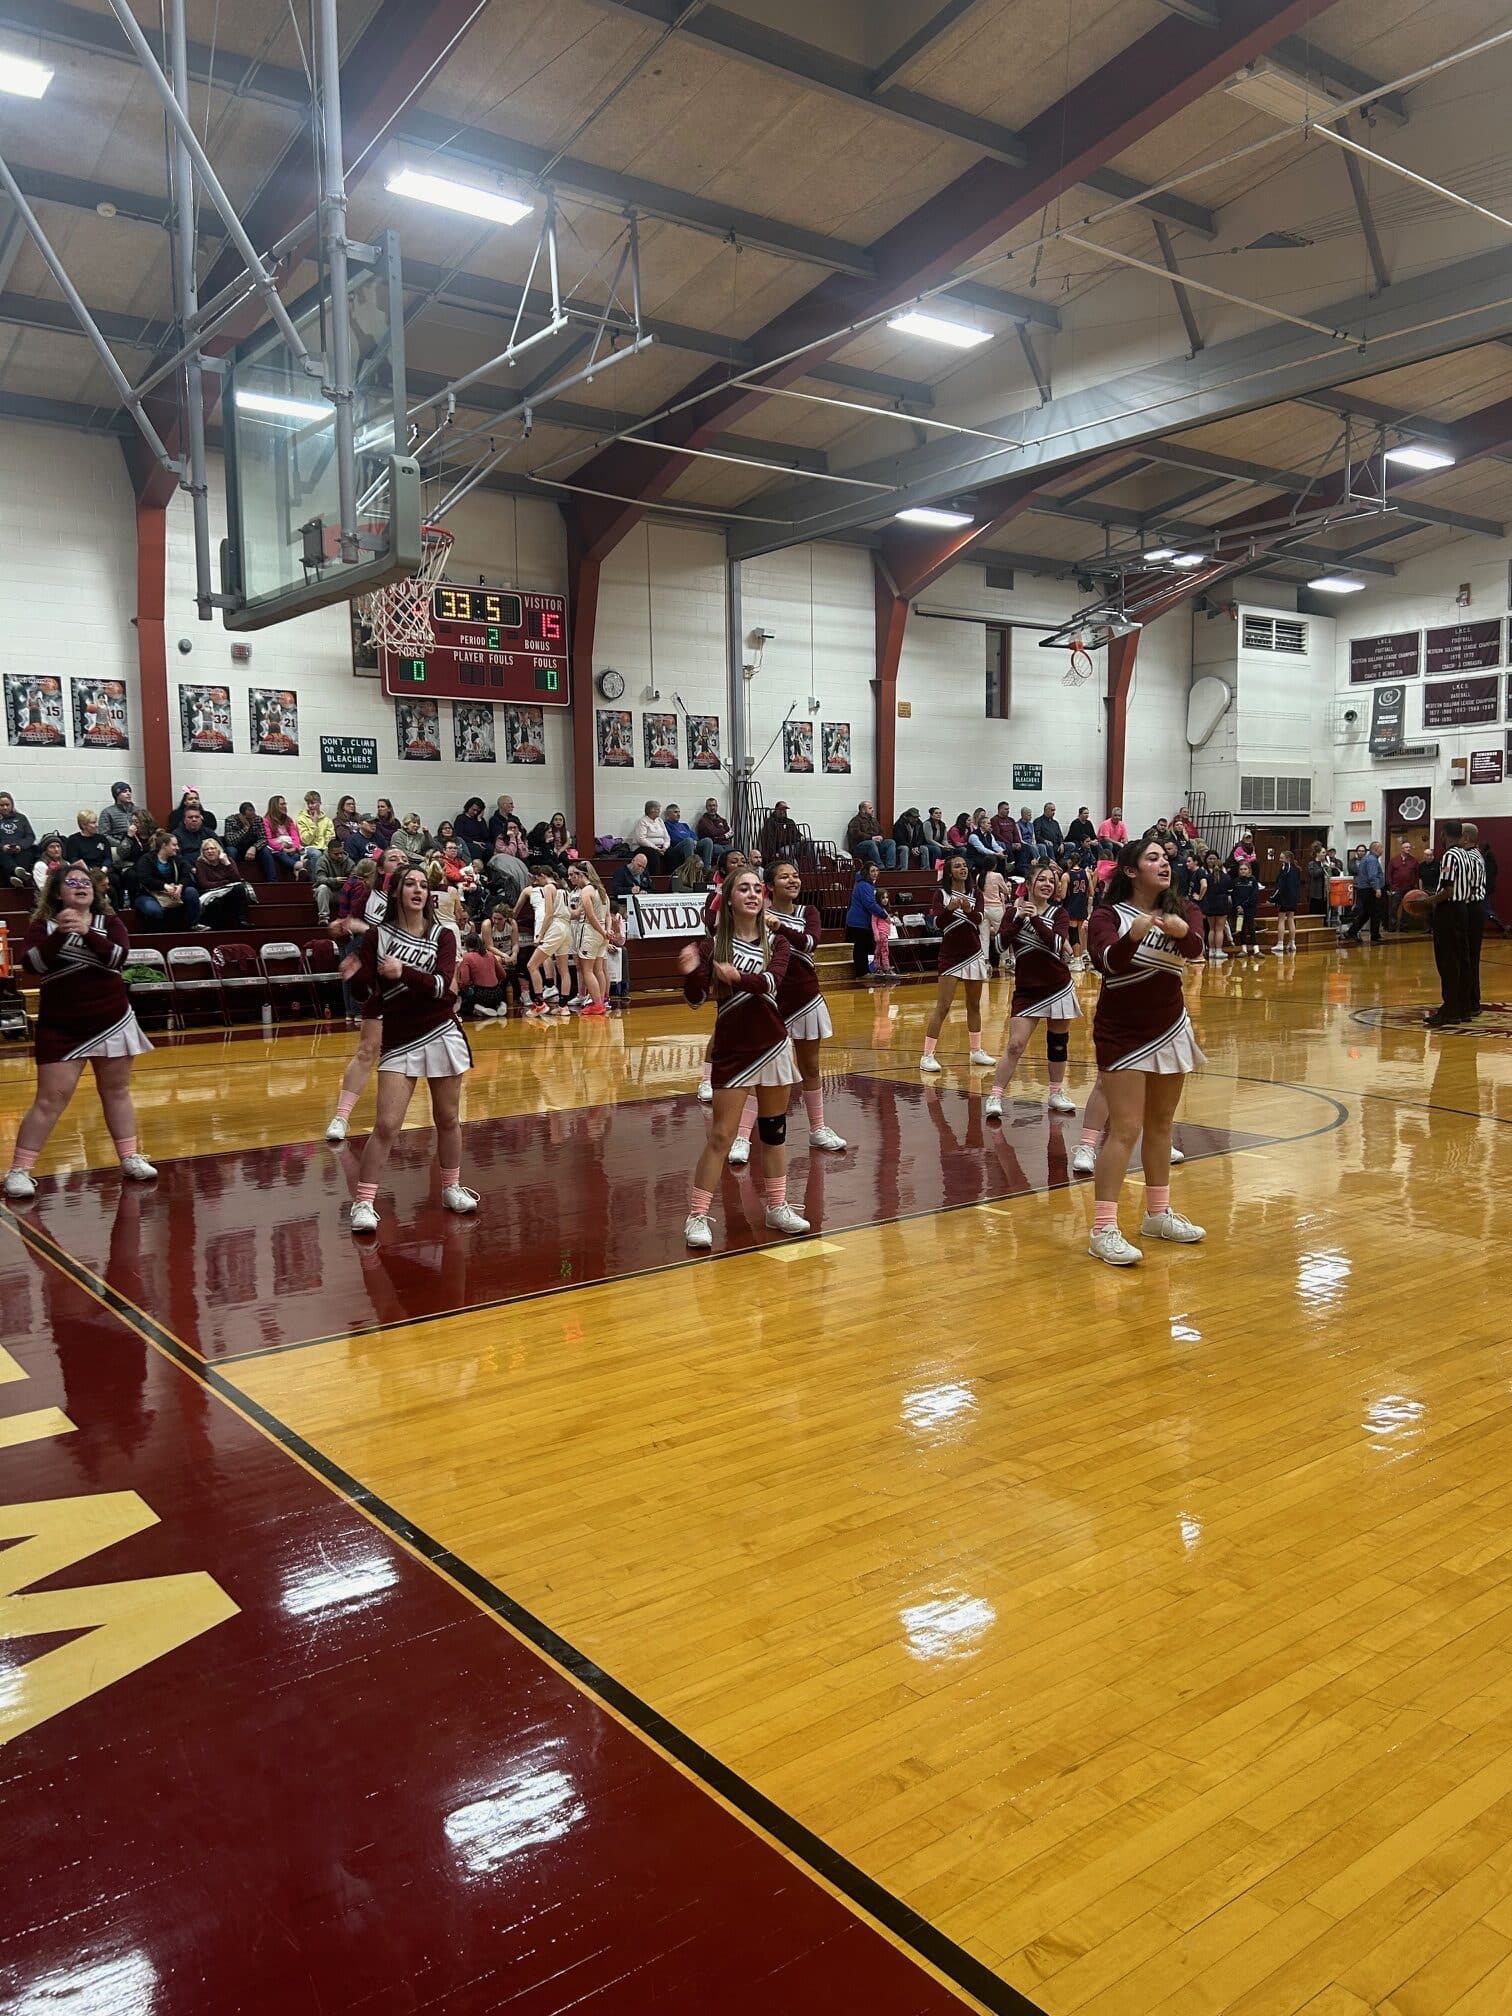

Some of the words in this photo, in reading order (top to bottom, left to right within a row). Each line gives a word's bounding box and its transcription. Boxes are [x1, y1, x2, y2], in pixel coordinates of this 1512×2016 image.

[524, 596, 562, 611] VISITOR
[542, 612, 560, 639] 15
[460, 634, 486, 646] PERIOD
[488, 628, 499, 648] 2
[524, 639, 550, 651] BONUS
[453, 650, 484, 663] PLAYER
[489, 653, 514, 666] FOULS
[533, 657, 557, 668] FOULS
[413, 660, 425, 681] 0
[547, 670, 558, 690] 0
[46, 706, 60, 716] 15
[110, 709, 124, 719] 10
[214, 714, 229, 724] 32
[284, 718, 296, 728] 21
[427, 725, 435, 735] 5
[350, 739, 375, 747] CLIMB
[805, 743, 811, 751] 5
[324, 746, 335, 754] OR
[341, 747, 355, 755] SIT
[327, 754, 372, 764] BLEACHERS
[1073, 880, 1086, 894] 24
